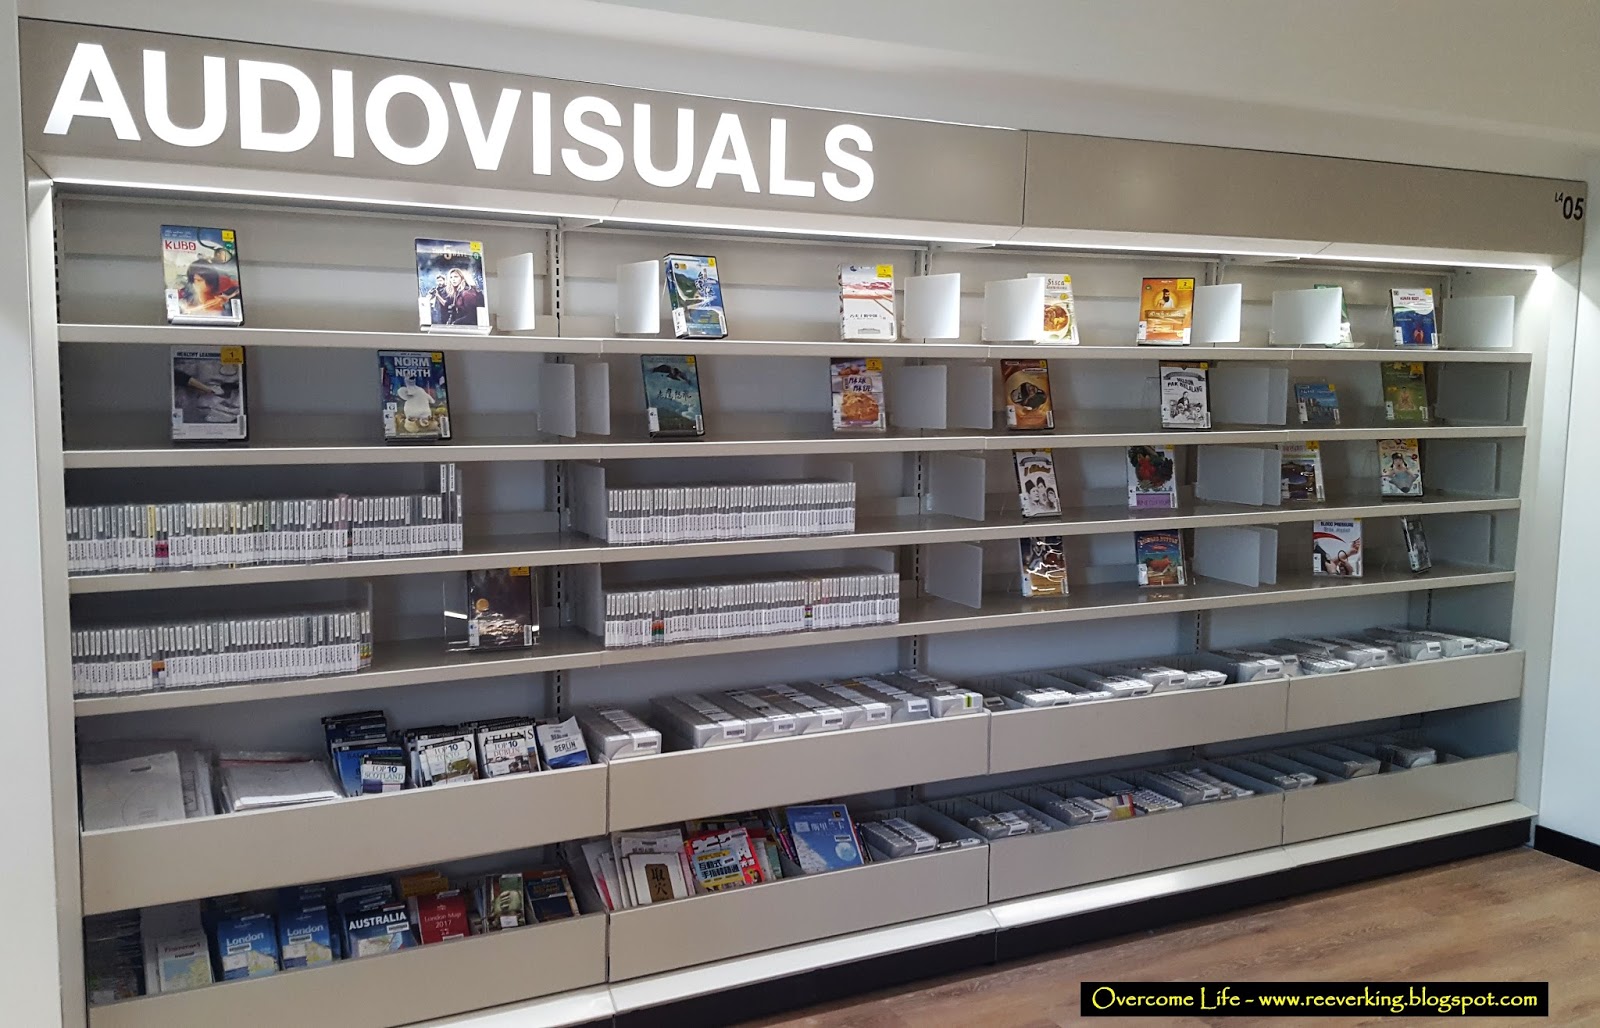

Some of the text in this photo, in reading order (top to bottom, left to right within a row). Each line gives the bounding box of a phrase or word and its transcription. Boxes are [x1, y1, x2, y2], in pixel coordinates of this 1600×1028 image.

[43, 42, 875, 203] AUDIOVISUALS
[1563, 196, 1584, 221] 05
[394, 357, 430, 367] NORM
[395, 369, 431, 378] NORTH
[448, 743, 459, 751] 10
[553, 741, 577, 753] BERLIN
[387, 765, 398, 773] 10
[364, 771, 404, 780] SCOTLAND
[349, 912, 407, 931] AUSTRALIA
[435, 920, 452, 929] 2017
[286, 924, 324, 937] London
[226, 932, 264, 946] London
